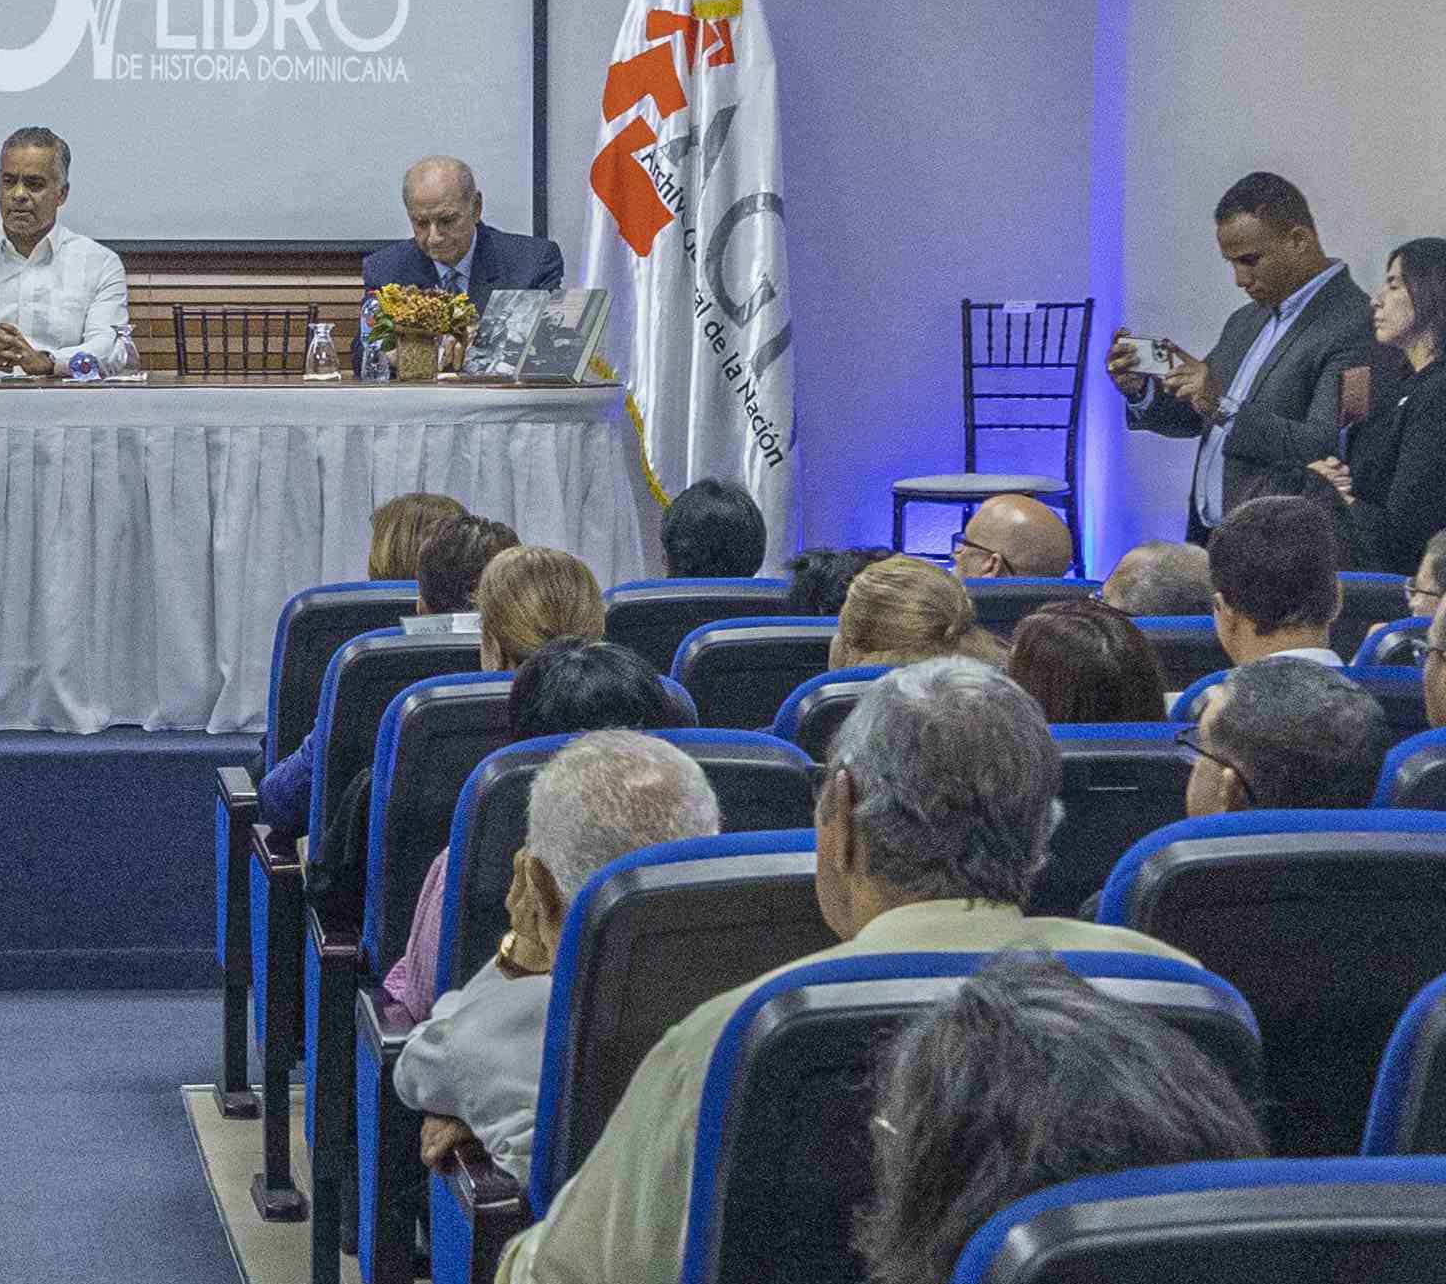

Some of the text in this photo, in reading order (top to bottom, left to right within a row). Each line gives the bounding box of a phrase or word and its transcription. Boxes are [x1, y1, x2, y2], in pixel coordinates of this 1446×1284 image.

[116, 54, 409, 83] DE HISTORIA DOMINICANA
[703, 319, 727, 355] de
[721, 351, 742, 381] la
[736, 379, 785, 468] Nación
